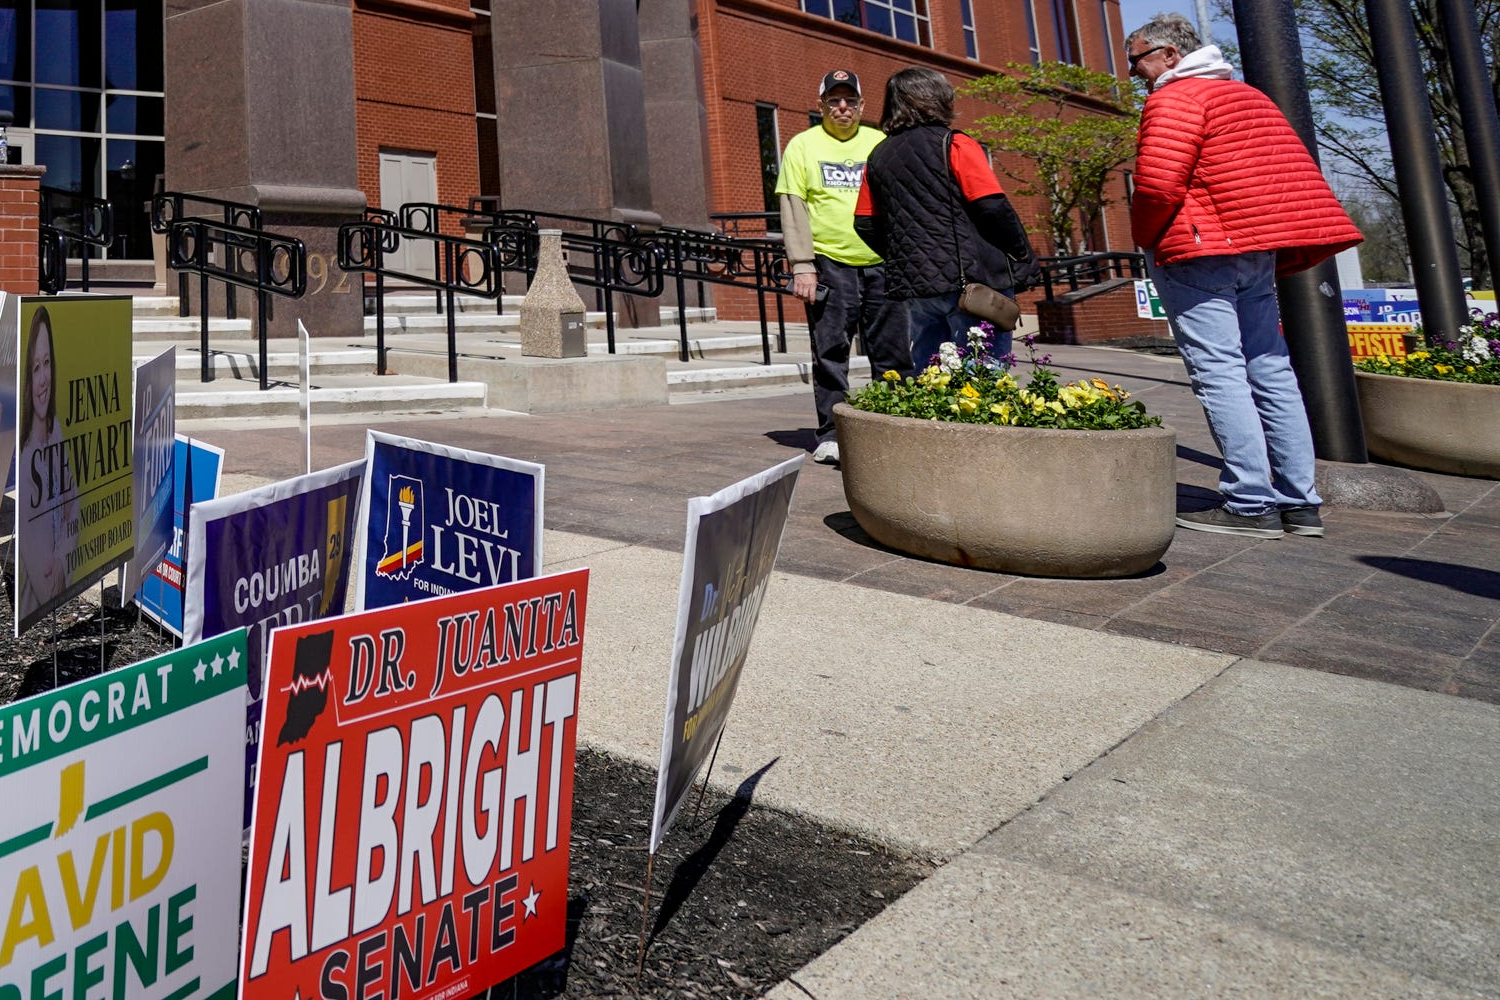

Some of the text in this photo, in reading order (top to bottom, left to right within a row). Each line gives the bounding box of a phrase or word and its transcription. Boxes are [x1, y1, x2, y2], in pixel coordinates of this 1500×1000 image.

[823, 169, 864, 182] LOW
[1347, 333, 1406, 356] PFISTE
[1386, 311, 1422, 330] FOR
[65, 371, 121, 428] JENNA
[29, 419, 133, 509] STEWART
[141, 395, 174, 512] FORD
[66, 521, 80, 539] FOR
[79, 486, 132, 531] NOBLESVILLE
[443, 486, 509, 539] JOEL
[65, 530, 107, 575] TOWNSHIP
[107, 518, 133, 547] BOARD
[328, 531, 344, 560] 29
[430, 524, 522, 587] LEVI
[234, 548, 321, 615] COUMBA
[414, 577, 430, 592] FOR
[344, 626, 417, 706] DR.
[430, 588, 581, 700] JUANITA
[249, 672, 578, 980] ALBRIGHT
[319, 872, 519, 1000] SENATE
